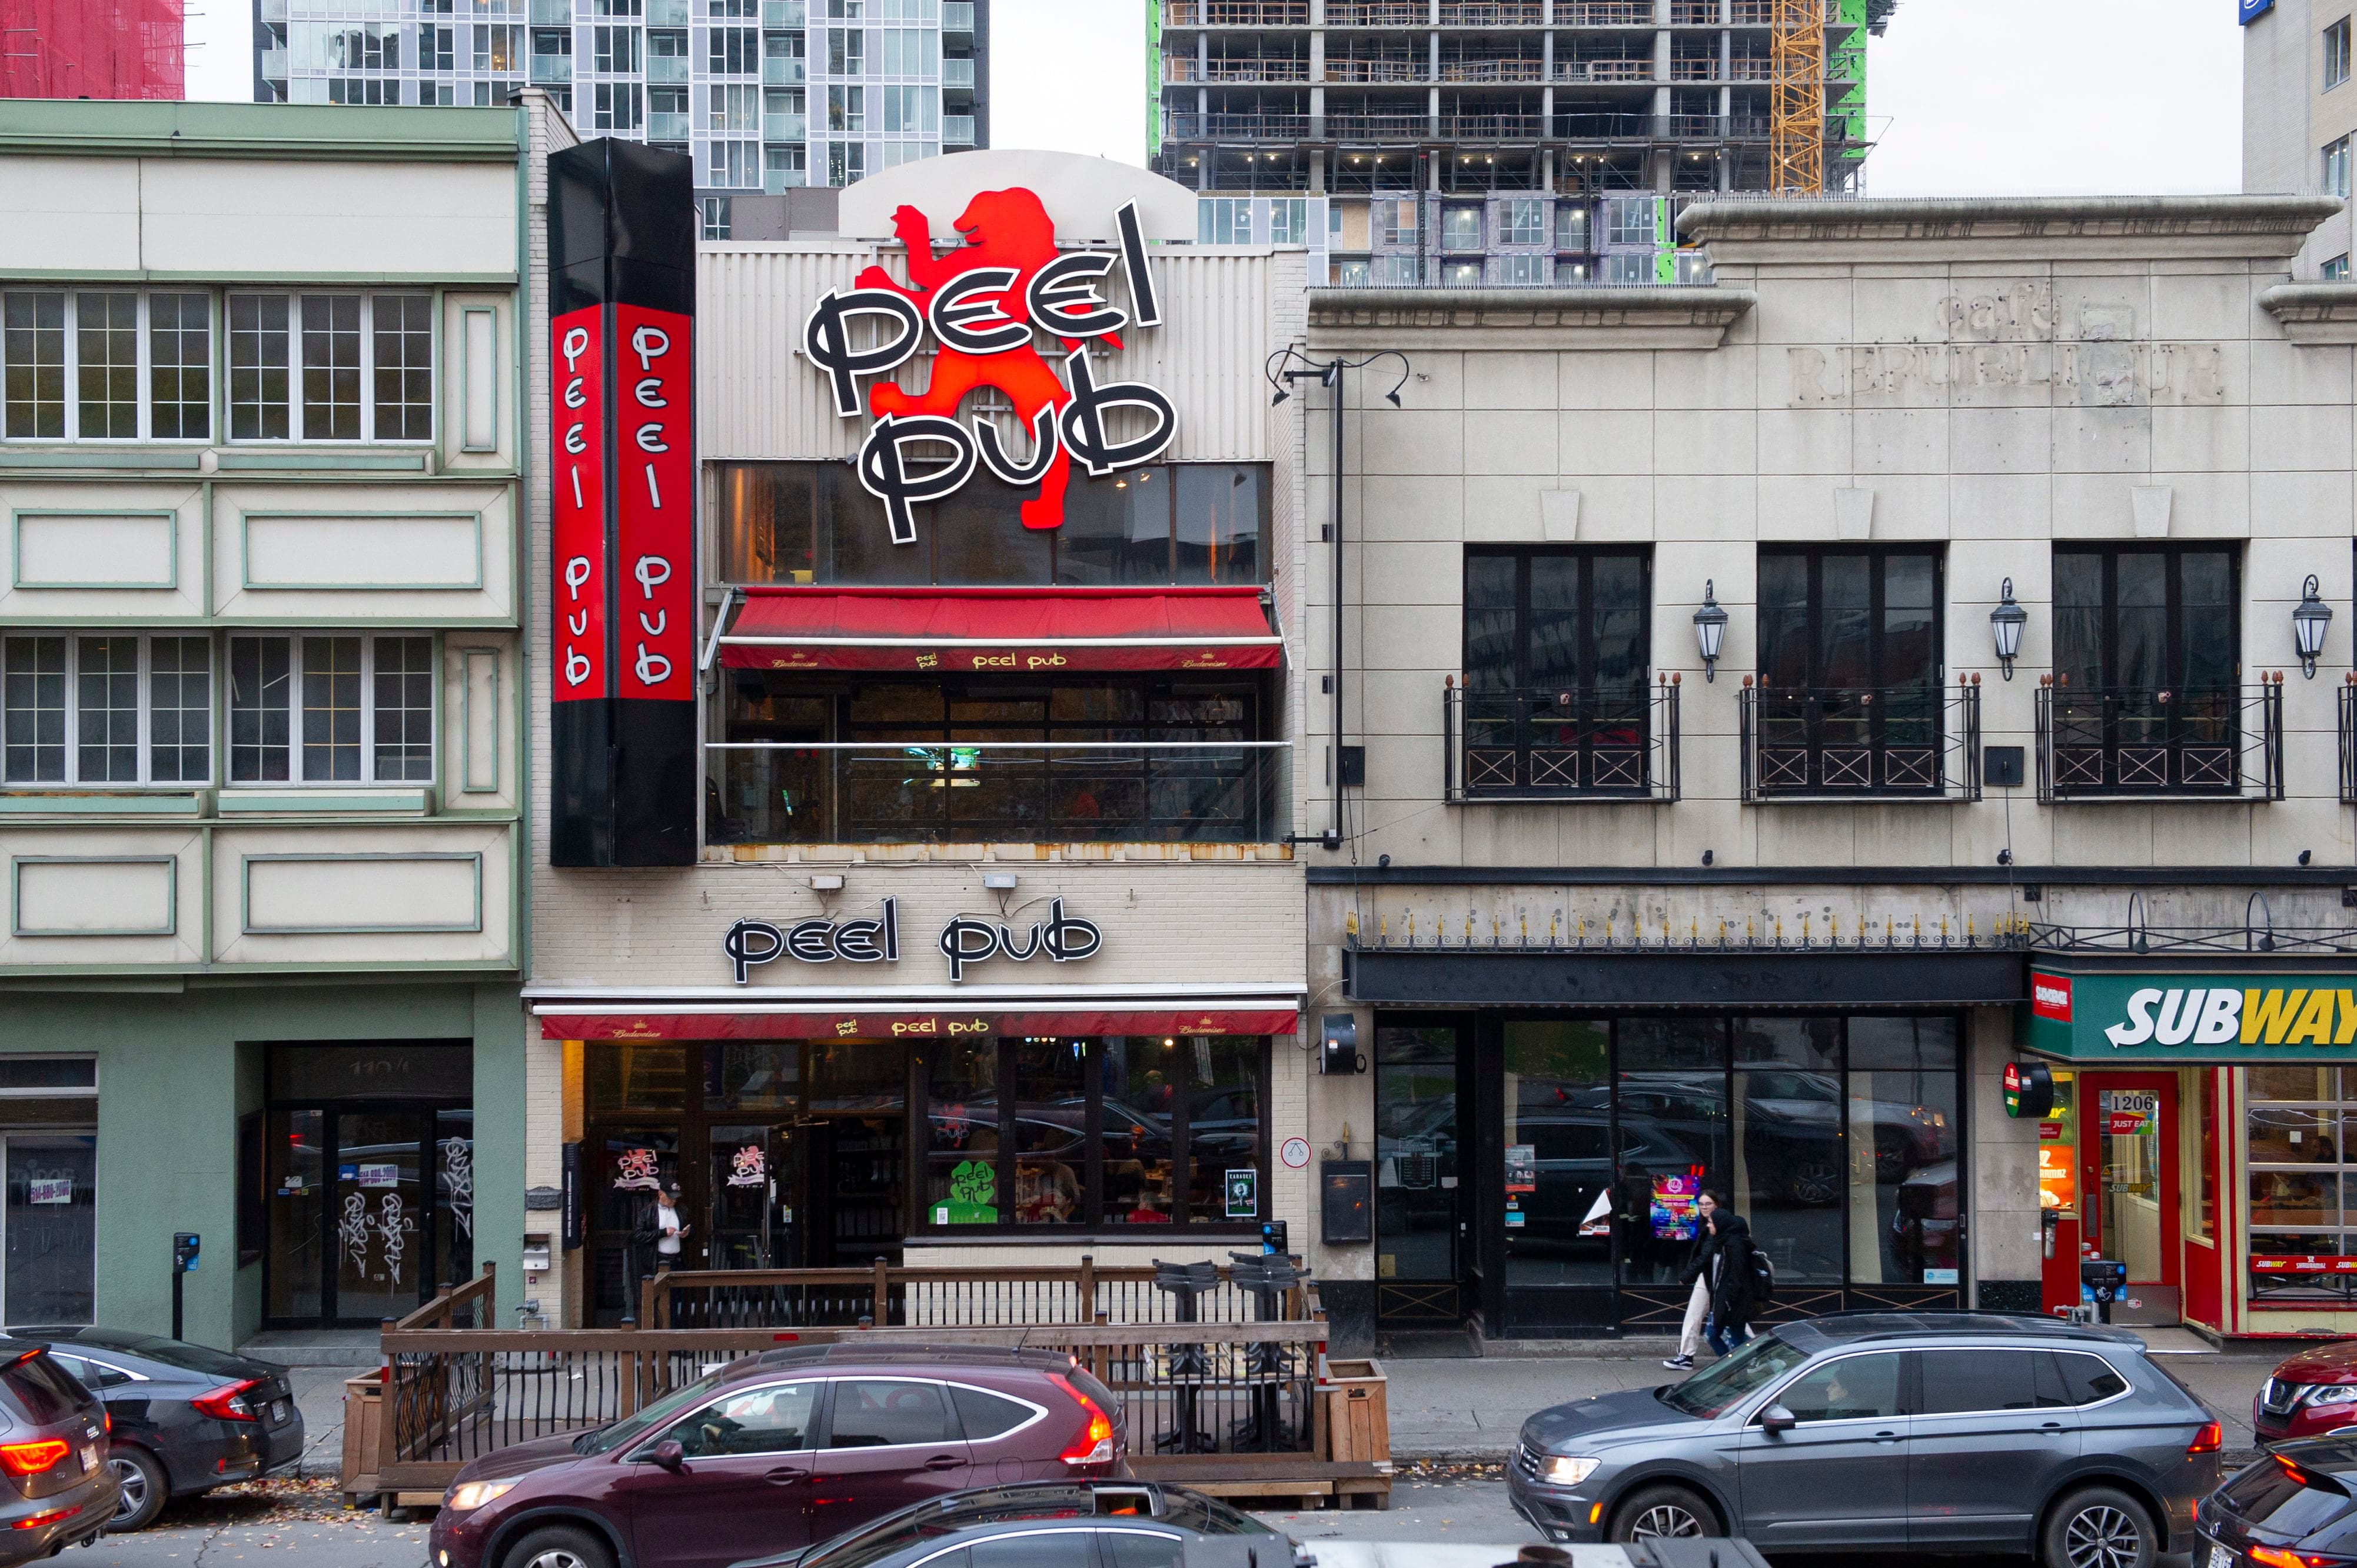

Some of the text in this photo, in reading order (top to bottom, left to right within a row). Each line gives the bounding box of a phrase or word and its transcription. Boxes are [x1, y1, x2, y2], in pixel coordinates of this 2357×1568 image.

[1787, 344, 2222, 407] REPUBLIUE
[857, 344, 1178, 544] pub
[565, 555, 591, 686] pub
[635, 555, 671, 685] pub
[772, 659, 819, 668] Budweiser
[1028, 653, 1067, 667] pub
[1182, 660, 1228, 668] Budweiser
[939, 895, 1103, 982] pub
[613, 1029, 662, 1038] Budweiser
[948, 1018, 989, 1036] pub
[1179, 1025, 1226, 1034] Budweiser
[2113, 1096, 2154, 1111] 1206
[2113, 1120, 2133, 1128] JUST
[2109, 1183, 2152, 1193] SUBWAY
